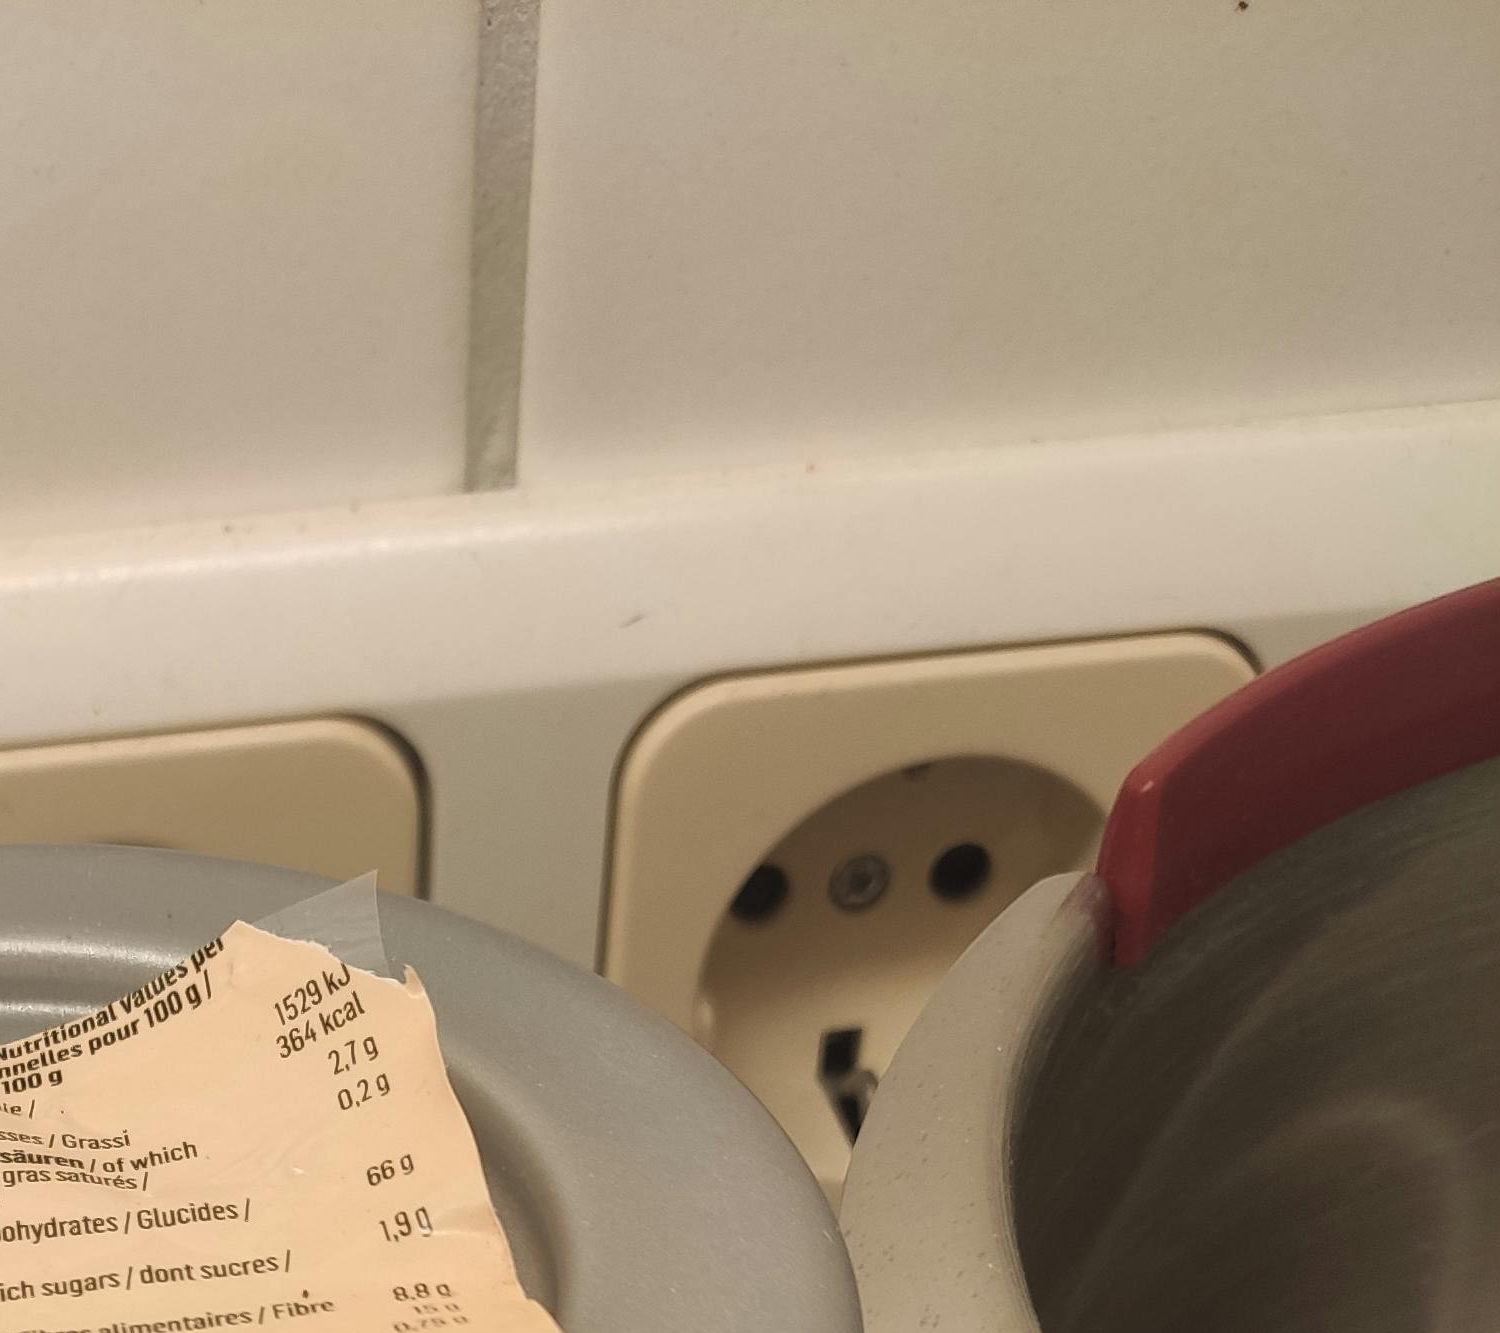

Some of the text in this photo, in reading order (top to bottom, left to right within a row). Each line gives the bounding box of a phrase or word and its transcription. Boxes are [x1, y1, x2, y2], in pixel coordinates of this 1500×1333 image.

[275, 991, 365, 1058] 364 kcal
[132, 1141, 198, 1170] which
[3, 1169, 50, 1186] gras
[367, 1160, 394, 1187] 66
[136, 1200, 238, 1231] Glucides
[41, 1274, 120, 1298] sugars
[139, 1263, 195, 1285] dont
[200, 1255, 280, 1277] sucres
[272, 1299, 336, 1320] Fibre
